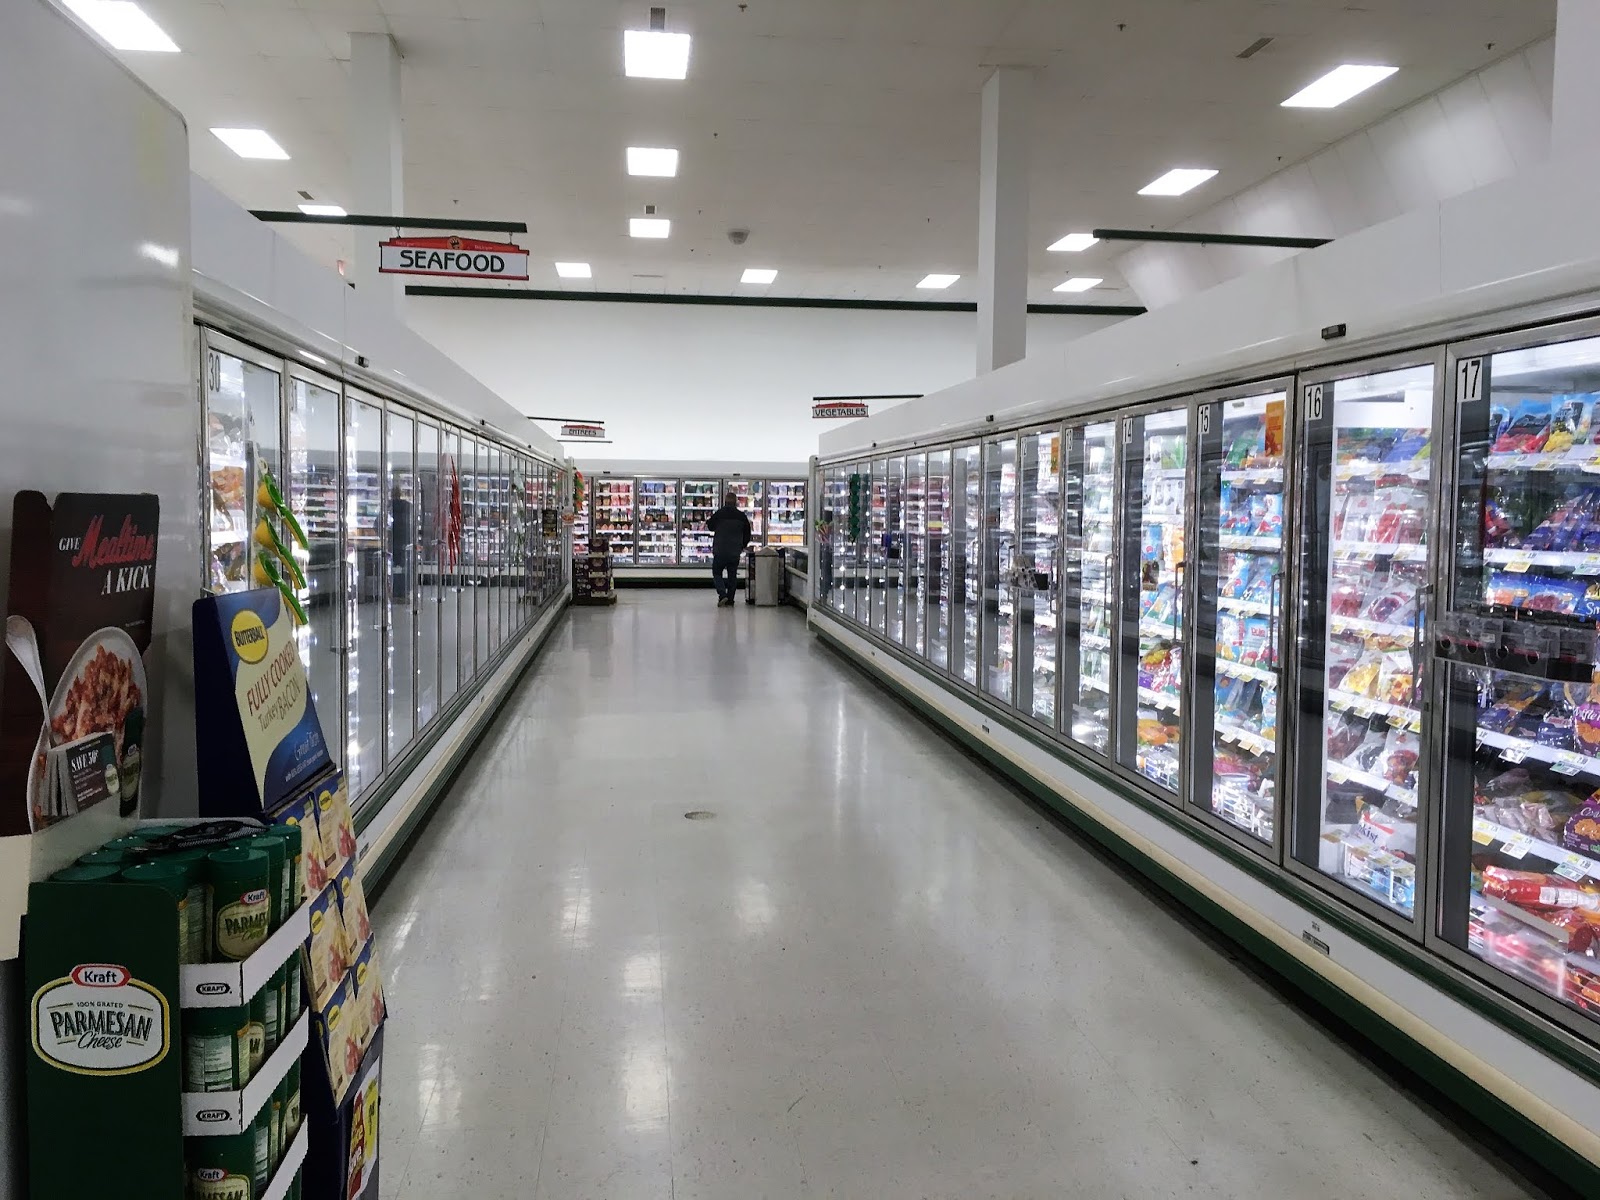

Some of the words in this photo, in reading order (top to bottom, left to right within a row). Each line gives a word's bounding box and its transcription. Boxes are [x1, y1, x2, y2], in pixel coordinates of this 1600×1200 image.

[400, 250, 505, 273] SEAFOOD
[208, 352, 221, 393] 30
[1462, 360, 1480, 399] 17
[815, 408, 866, 417] VEGETABLES
[1307, 386, 1321, 418] 16
[1123, 418, 1132, 443] 14
[1200, 406, 1209, 433] 15
[59, 537, 81, 551] GIVE
[101, 569, 112, 596] A
[115, 564, 152, 593] KICK
[234, 625, 265, 647] BUTTERBALL
[246, 671, 271, 717] FULLY
[270, 640, 296, 688] COOKED
[278, 673, 301, 721] BACON
[247, 890, 265, 902] Kraft
[84, 970, 117, 984] Kraft
[76, 1001, 96, 1009] 100%
[97, 1001, 124, 1009] GRATED
[50, 1010, 153, 1042] PARMESAN
[77, 1030, 123, 1050] Cheese
[199, 1169, 220, 1179] Kraft
